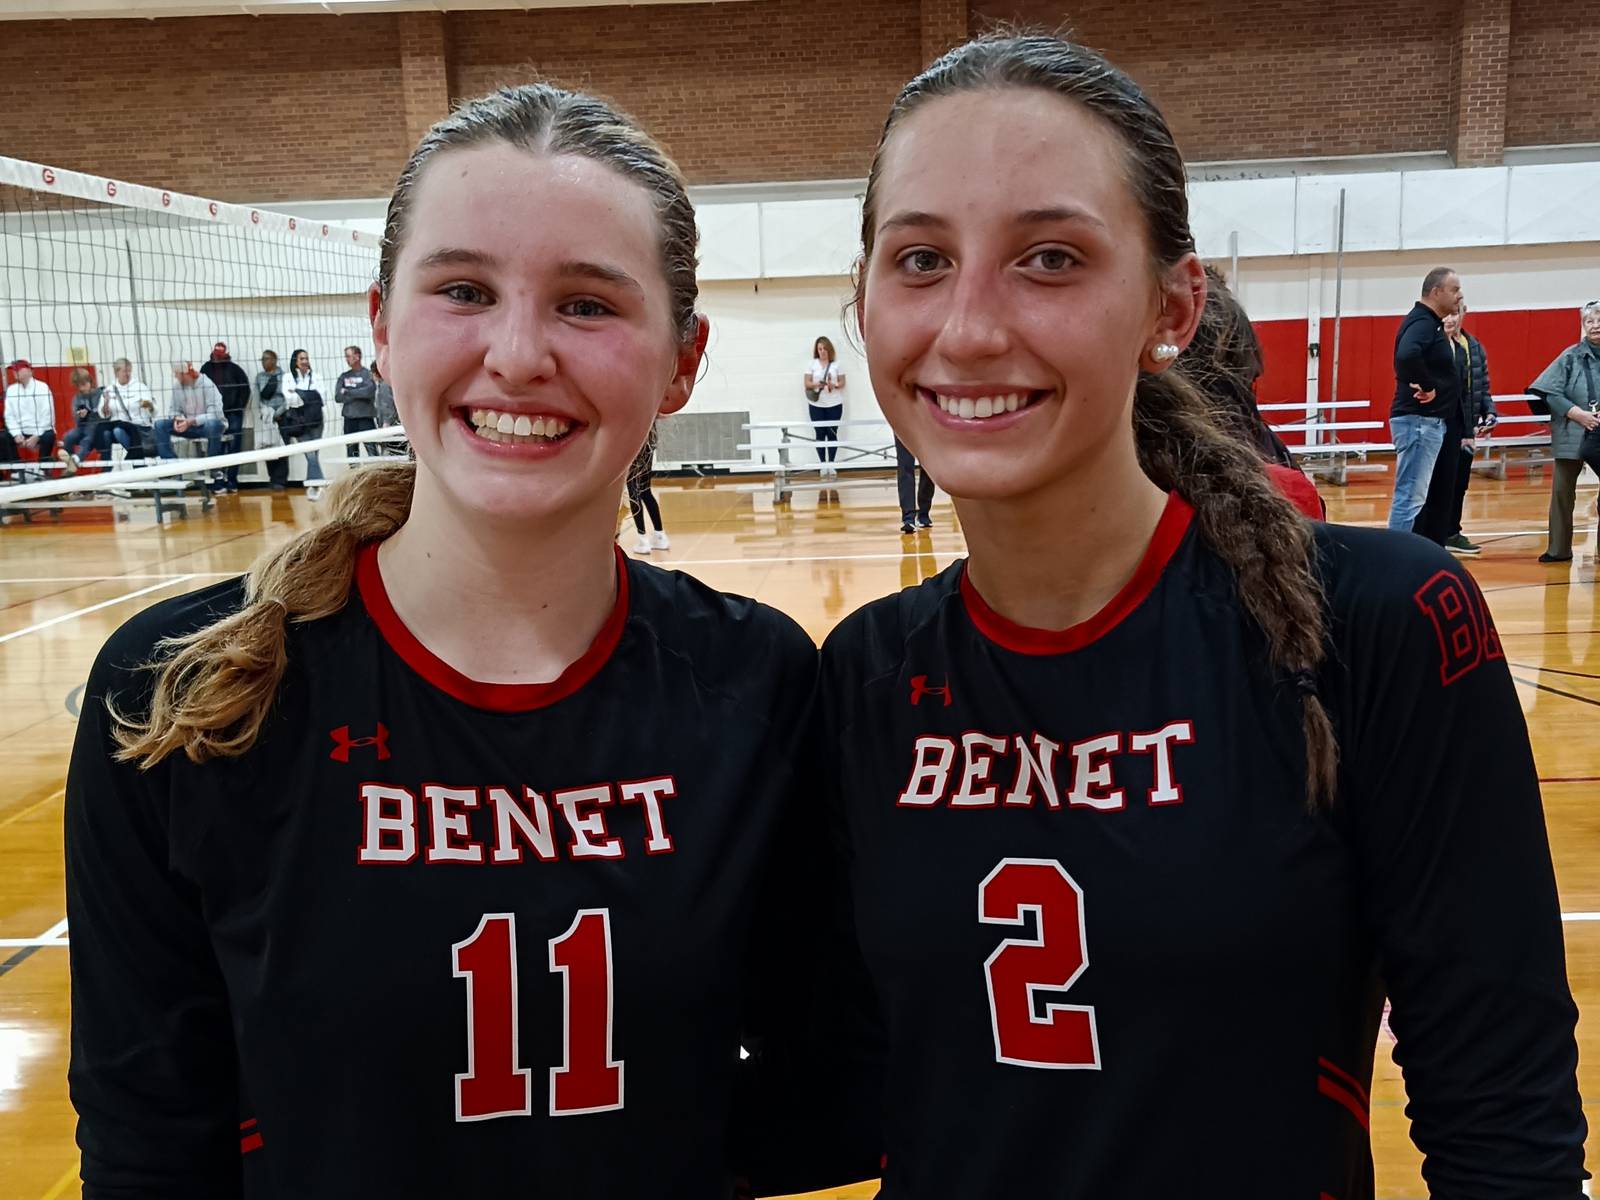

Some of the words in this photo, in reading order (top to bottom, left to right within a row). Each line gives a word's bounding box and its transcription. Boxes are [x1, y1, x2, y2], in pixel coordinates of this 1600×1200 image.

[42, 168, 55, 185] G
[107, 181, 117, 197] G
[162, 192, 171, 207] G
[896, 719, 1195, 813] BENET
[357, 775, 677, 865] BENET
[978, 857, 1102, 1071] 2
[451, 907, 624, 1122] 11
